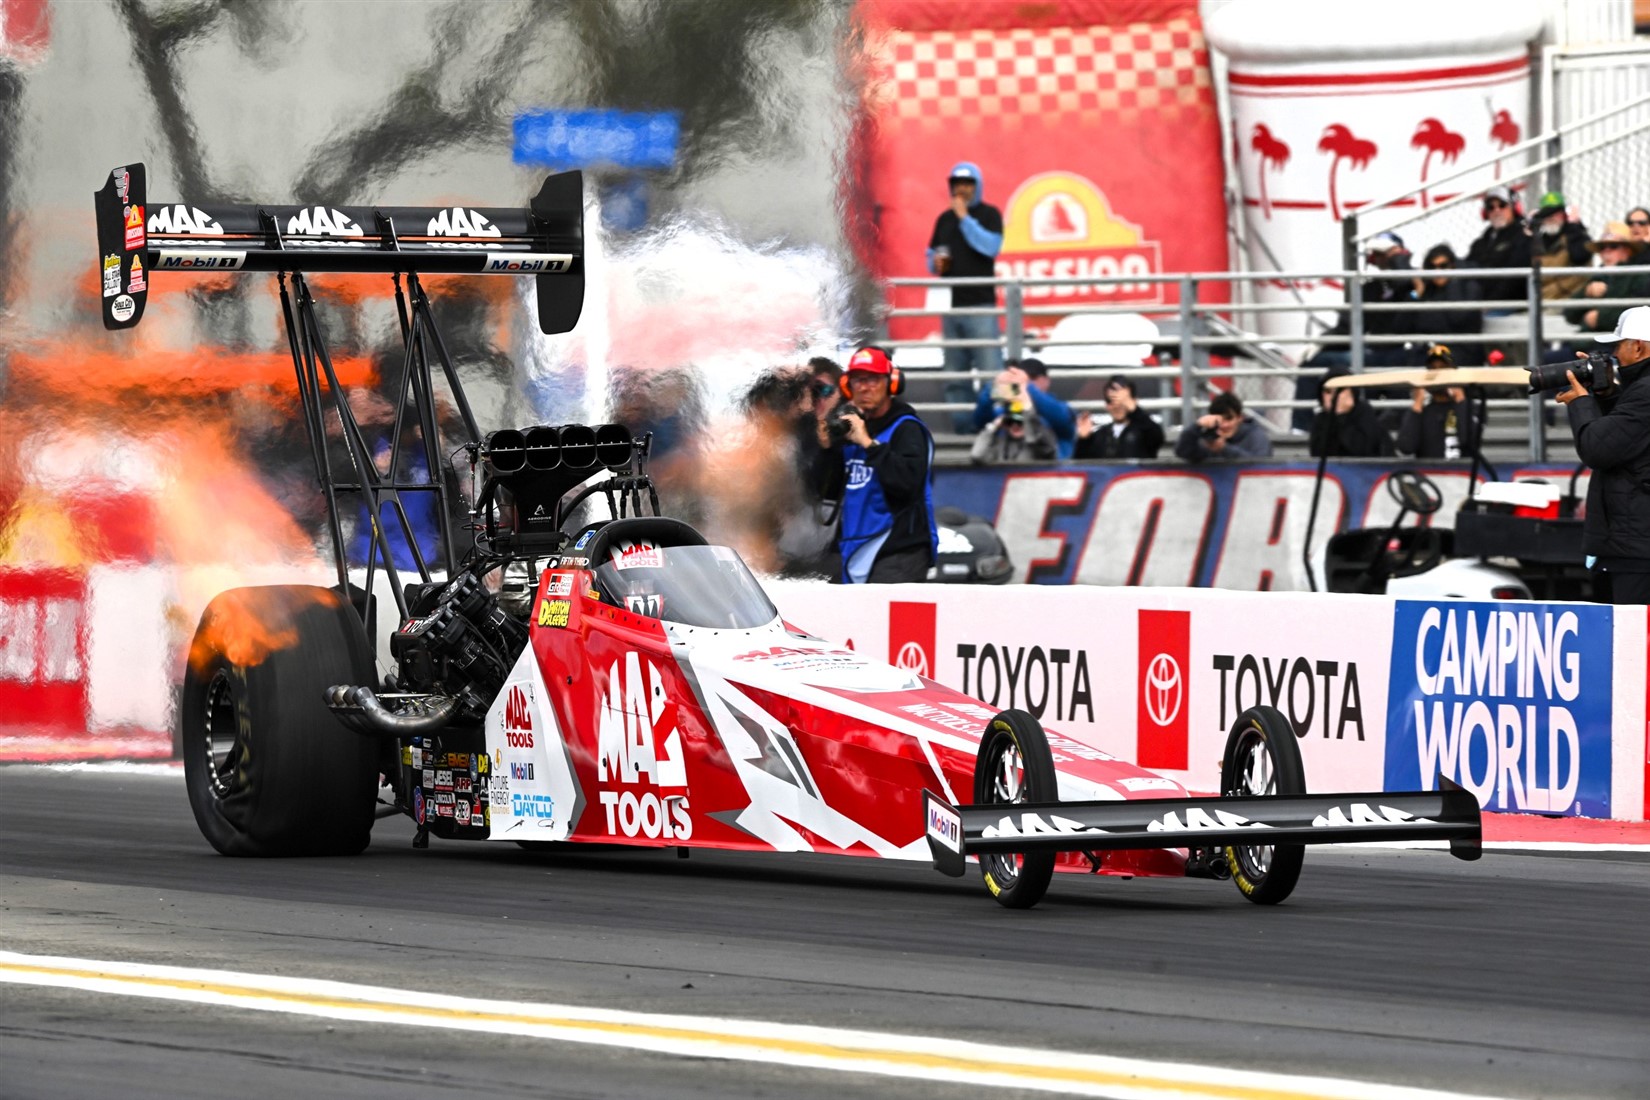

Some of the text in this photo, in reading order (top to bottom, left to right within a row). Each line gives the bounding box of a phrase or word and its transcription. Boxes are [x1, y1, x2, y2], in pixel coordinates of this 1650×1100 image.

[147, 204, 225, 235] MAC
[287, 206, 365, 237] MAC
[427, 207, 502, 238] MAC
[163, 256, 217, 268] Mobil
[490, 259, 543, 271] Mobil
[1416, 606, 1580, 702] CAMPING
[957, 642, 1095, 724] TOYOTA
[505, 685, 533, 731] MAC
[1213, 653, 1365, 742] TOYOTA
[598, 651, 688, 788] MAC
[506, 732, 534, 748] TOOLS
[1414, 701, 1581, 813] WORLD
[456, 777, 471, 790] ARP
[490, 775, 509, 790] FUTURE
[511, 762, 527, 780] Mobil
[490, 791, 510, 805] ENERGY
[513, 793, 552, 818] DAYCO
[599, 790, 693, 841] TOOLS
[930, 809, 949, 837] Mobil
[981, 812, 1110, 838] MAC
[1147, 807, 1278, 832] MAC
[1312, 803, 1441, 827] MAC
